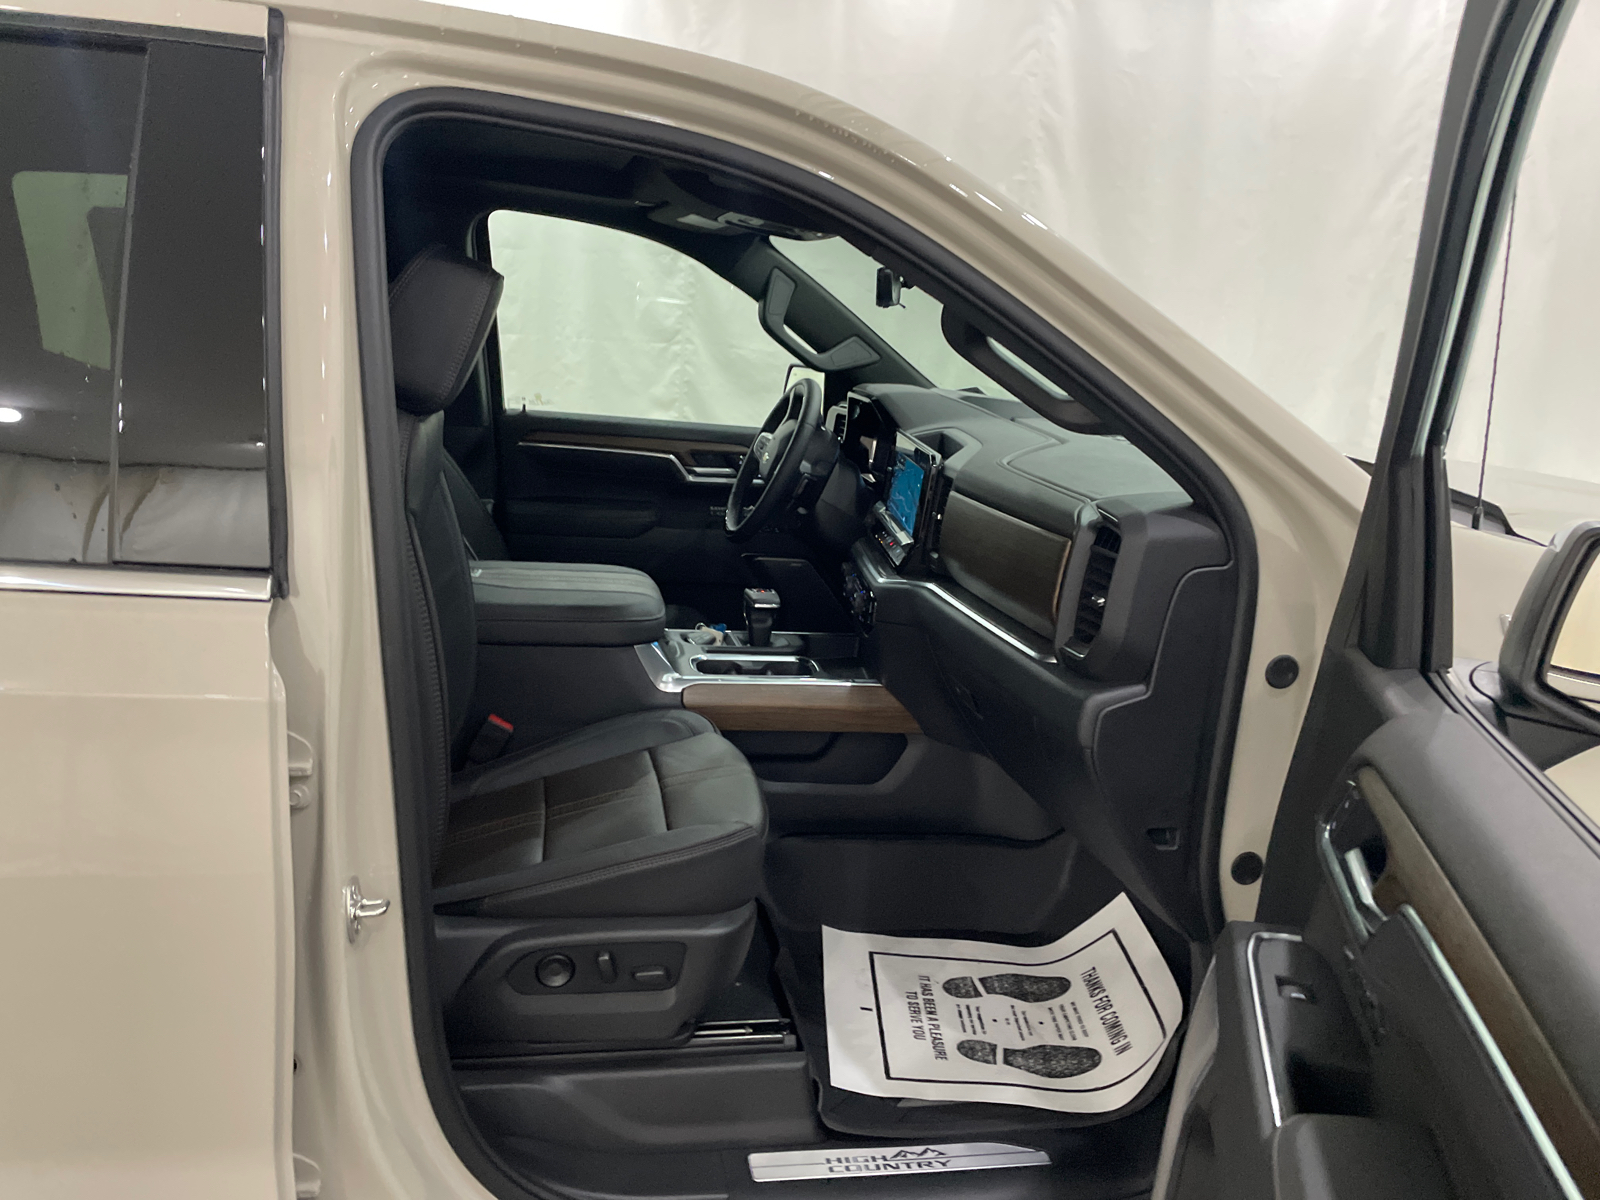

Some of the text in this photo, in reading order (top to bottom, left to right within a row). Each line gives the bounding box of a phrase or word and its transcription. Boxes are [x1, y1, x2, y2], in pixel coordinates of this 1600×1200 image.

[918, 974, 931, 982] IT
[919, 982, 934, 997] HAS
[922, 998, 938, 1016] BEEN
[1080, 966, 1133, 1056] THANKS FOR COMING IN
[905, 991, 927, 1041] TO SERVE YOU
[928, 1023, 949, 1061] PLEASURE
[825, 1155, 889, 1165] HIGH
[828, 1160, 951, 1173] COUNTRY
